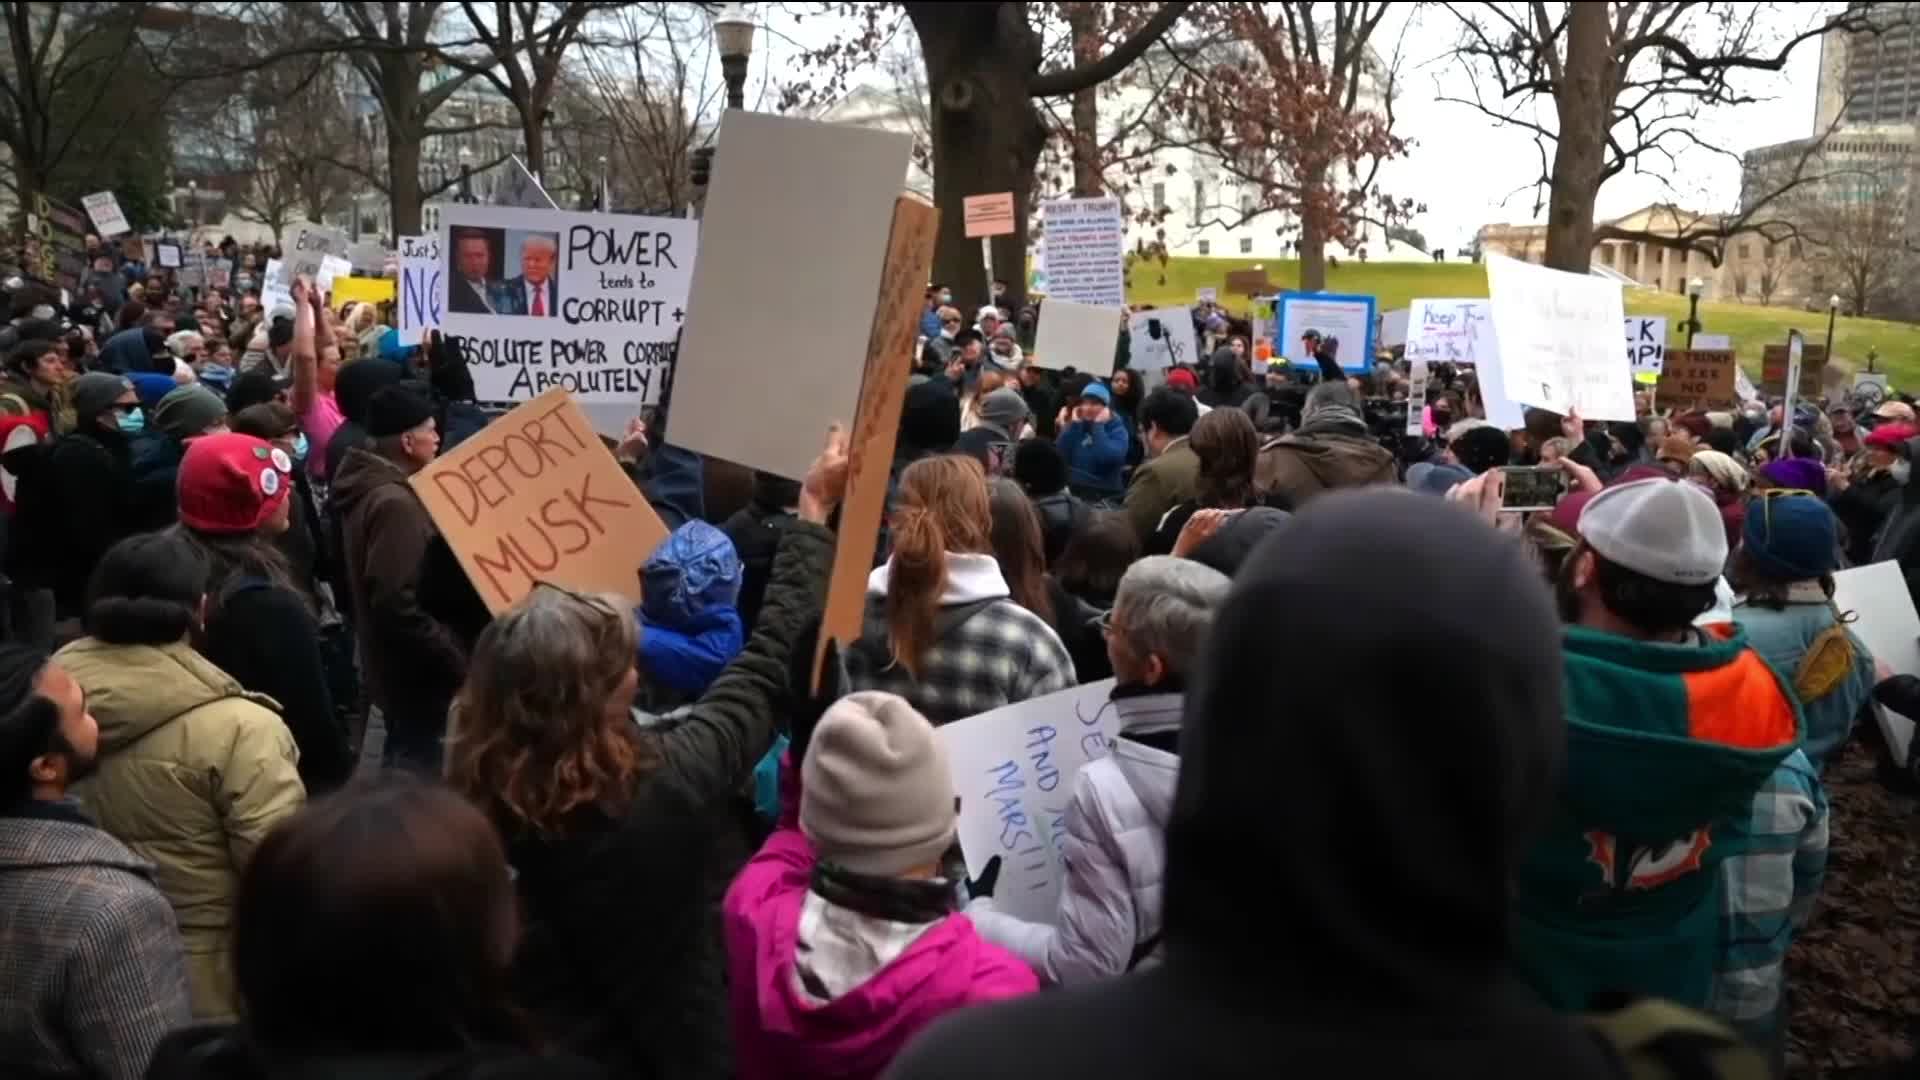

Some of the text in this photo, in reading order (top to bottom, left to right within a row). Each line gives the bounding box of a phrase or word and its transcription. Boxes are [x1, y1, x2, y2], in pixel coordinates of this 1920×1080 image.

[403, 239, 429, 257] Just
[567, 225, 678, 271] POWER
[600, 271, 656, 289] tends to
[562, 297, 667, 326] CORRUPT
[456, 336, 543, 368] BSOLUTE
[551, 338, 608, 367] POWER
[432, 401, 587, 527] DEPORT
[472, 472, 632, 603] MUSK
[1025, 725, 1058, 793] AND
